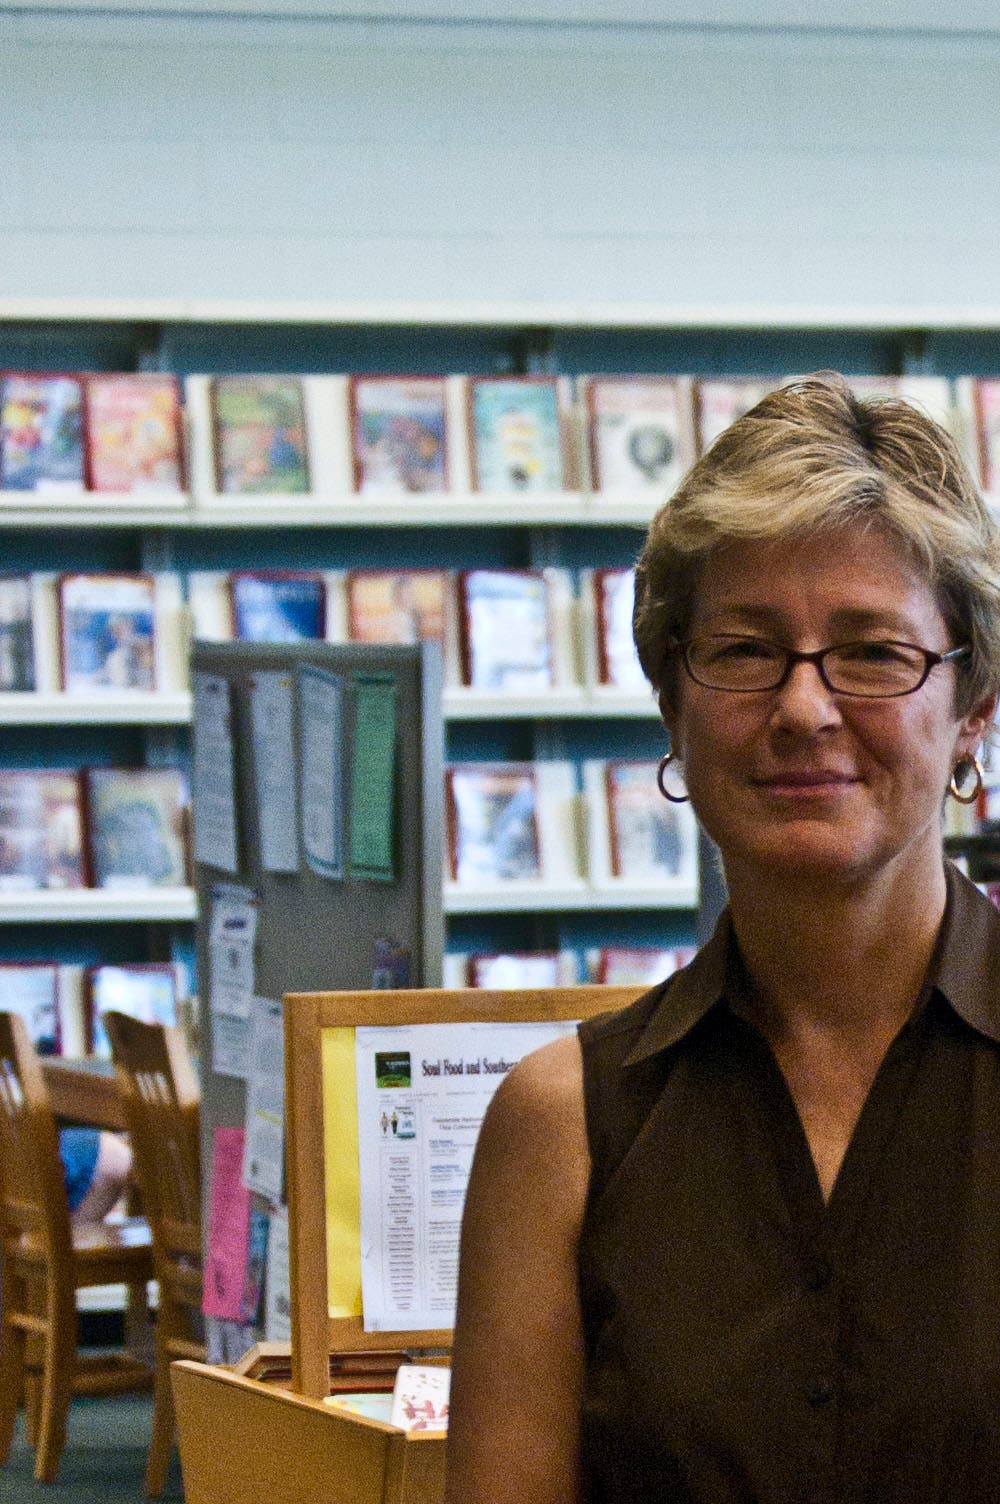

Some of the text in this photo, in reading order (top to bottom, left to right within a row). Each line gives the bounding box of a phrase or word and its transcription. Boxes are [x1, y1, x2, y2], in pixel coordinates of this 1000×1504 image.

[422, 1058, 440, 1076] Soul
[443, 1056, 463, 1075] Food
[466, 1057, 480, 1075] and
